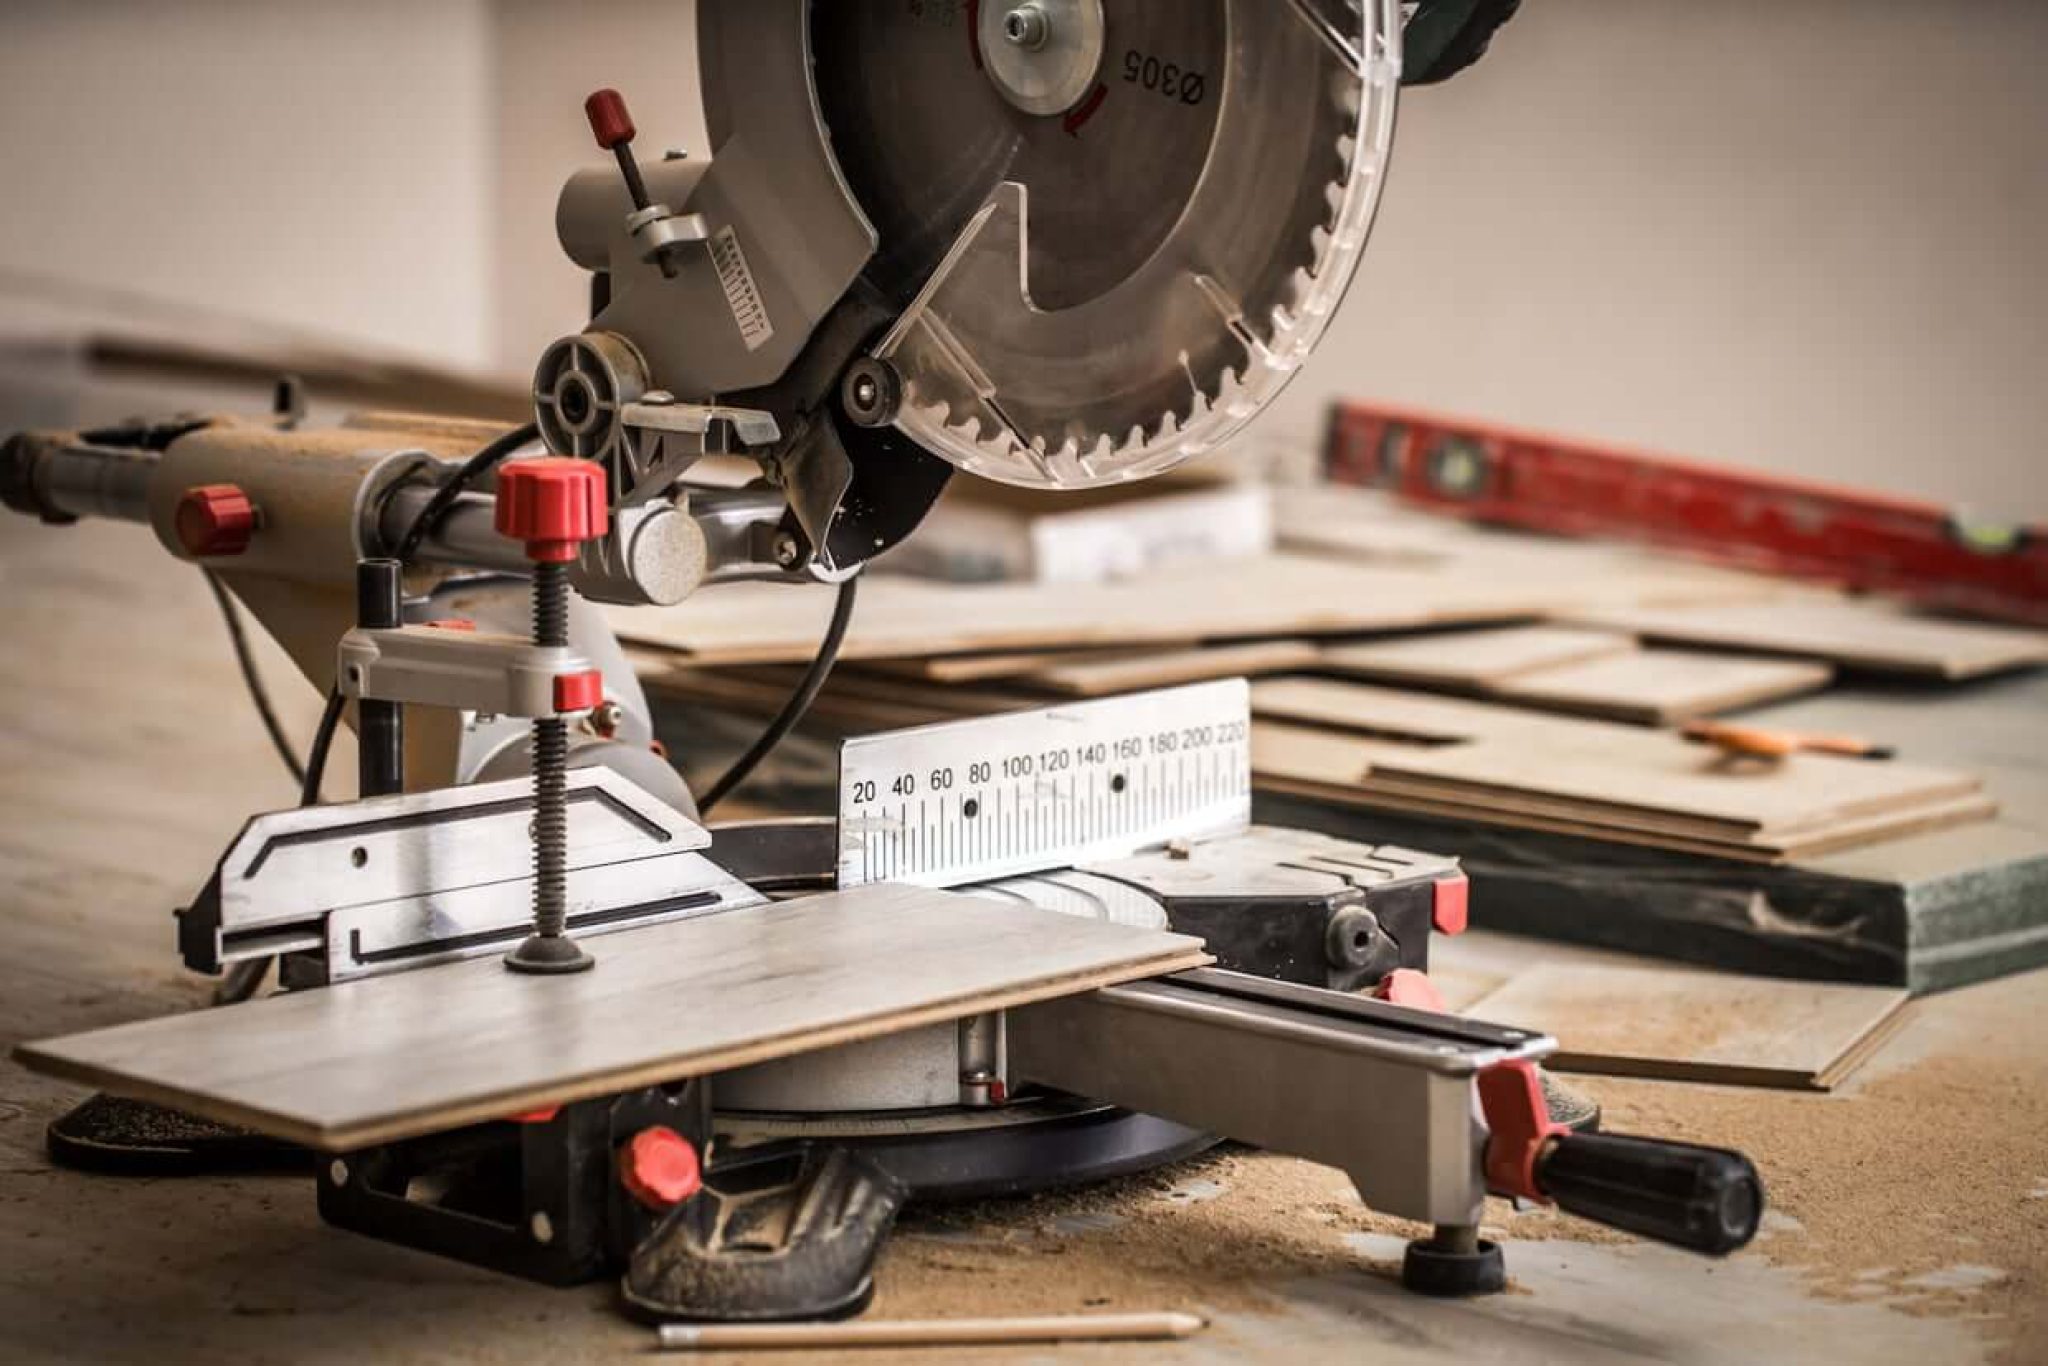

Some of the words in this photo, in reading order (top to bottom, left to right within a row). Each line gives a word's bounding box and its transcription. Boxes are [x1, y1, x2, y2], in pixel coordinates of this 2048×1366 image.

[854, 781, 875, 803] 20
[892, 774, 914, 796] 40
[931, 768, 952, 790] 60
[969, 762, 991, 783] 80
[1003, 755, 1032, 778] 100
[1040, 749, 1069, 772] 120
[1077, 743, 1105, 766] 140
[1113, 738, 1141, 759] 160
[1149, 732, 1177, 753] 180
[1183, 727, 1212, 748] 200
[1217, 721, 1245, 743] 220
